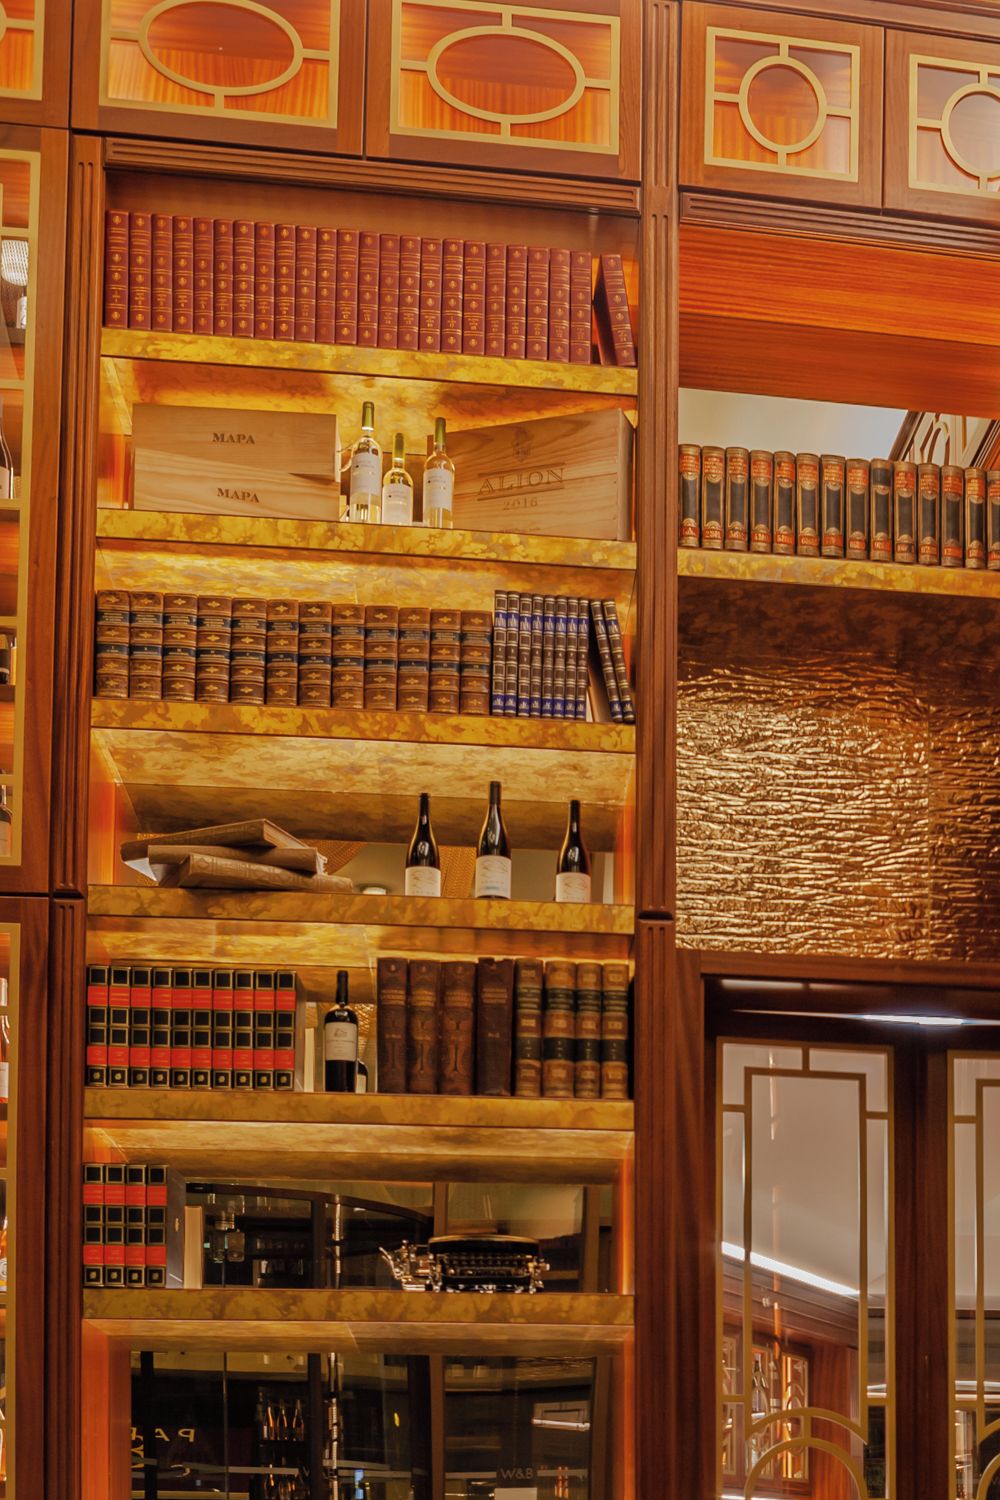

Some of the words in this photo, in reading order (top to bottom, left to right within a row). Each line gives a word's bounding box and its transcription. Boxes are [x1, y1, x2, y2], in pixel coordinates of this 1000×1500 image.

[212, 432, 256, 445] MAPA
[478, 467, 566, 496] ALION
[217, 487, 260, 503] MAPA
[503, 497, 539, 511] 2016
[500, 1467, 535, 1480] W&B
